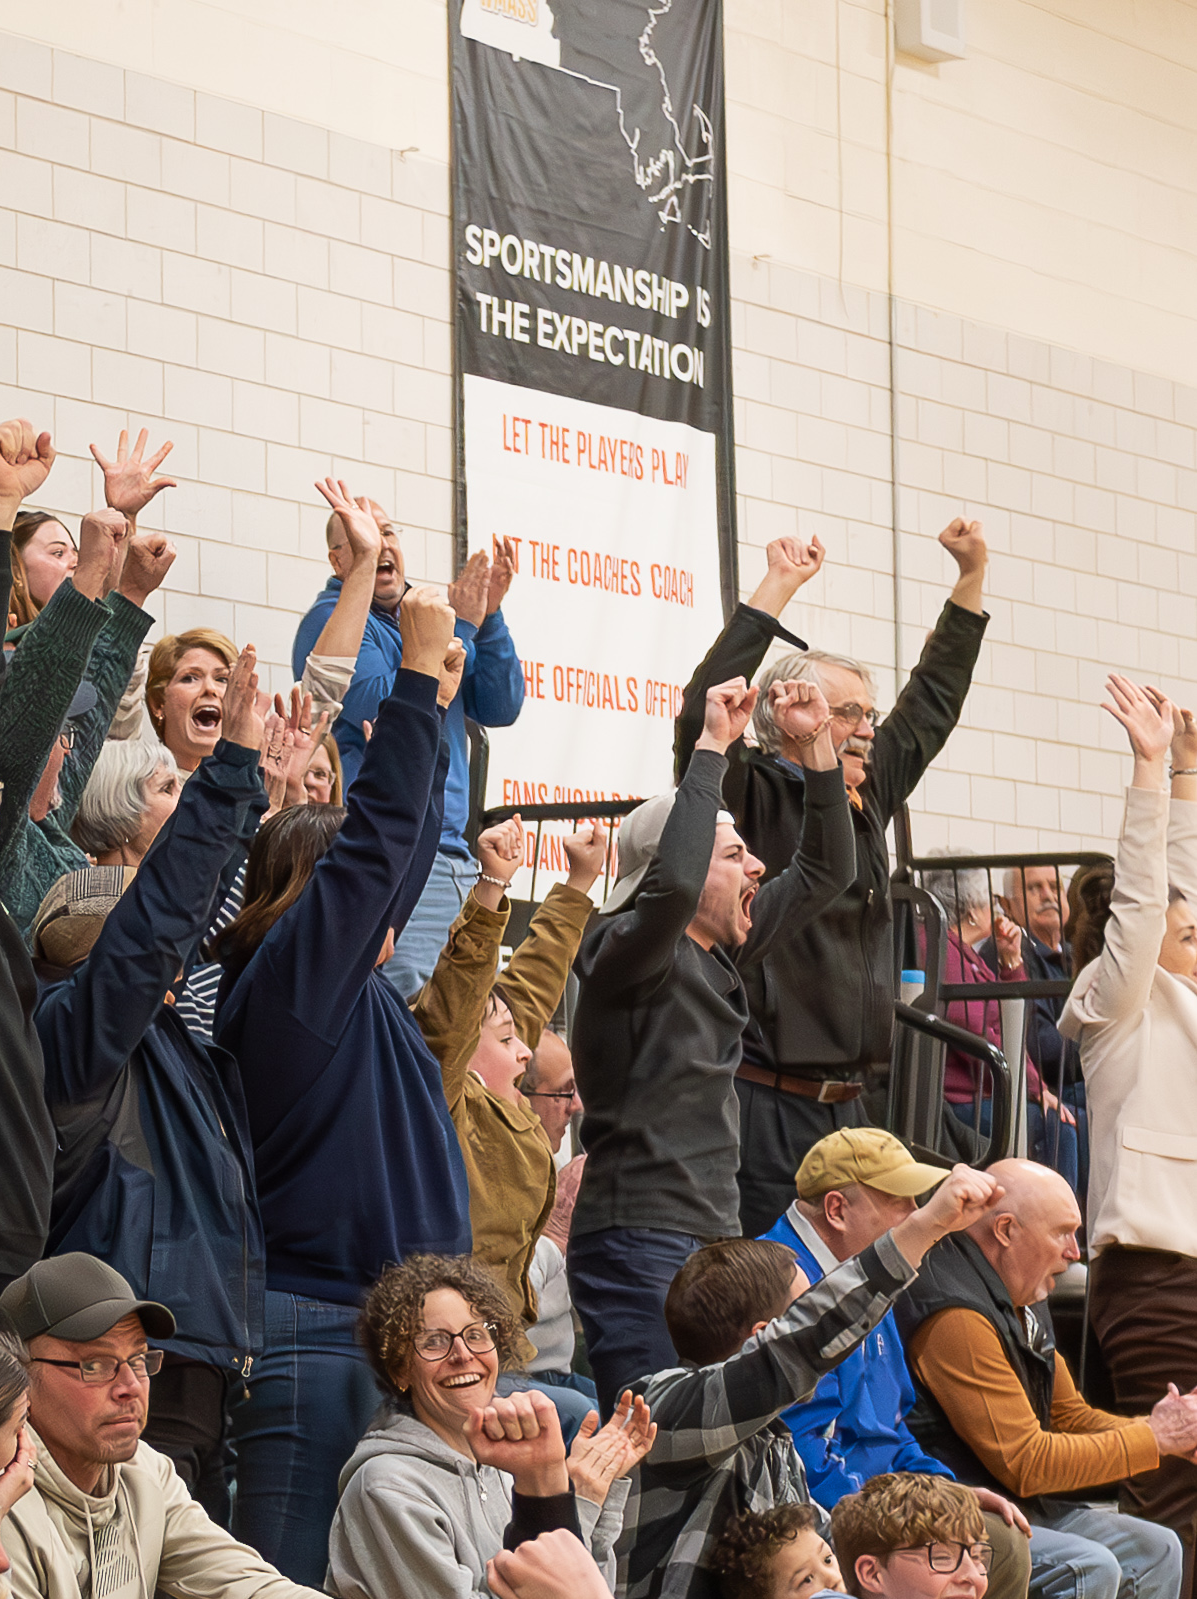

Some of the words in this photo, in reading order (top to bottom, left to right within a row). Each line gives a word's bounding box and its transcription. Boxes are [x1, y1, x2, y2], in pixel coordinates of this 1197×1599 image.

[464, 223, 690, 319] SPORTSMANSHIP
[696, 285, 711, 328] IS
[475, 292, 530, 344] THE
[537, 307, 704, 389] EXPECTATION
[503, 413, 532, 455] LET
[538, 422, 570, 464] THE
[576, 430, 643, 481] PLAYERS
[651, 447, 689, 489] PLAY
[492, 533, 522, 574] LT
[529, 540, 560, 582] THE
[567, 548, 641, 597] COACHES
[650, 563, 694, 608] COACH
[553, 665, 638, 713] OFFICIALS
